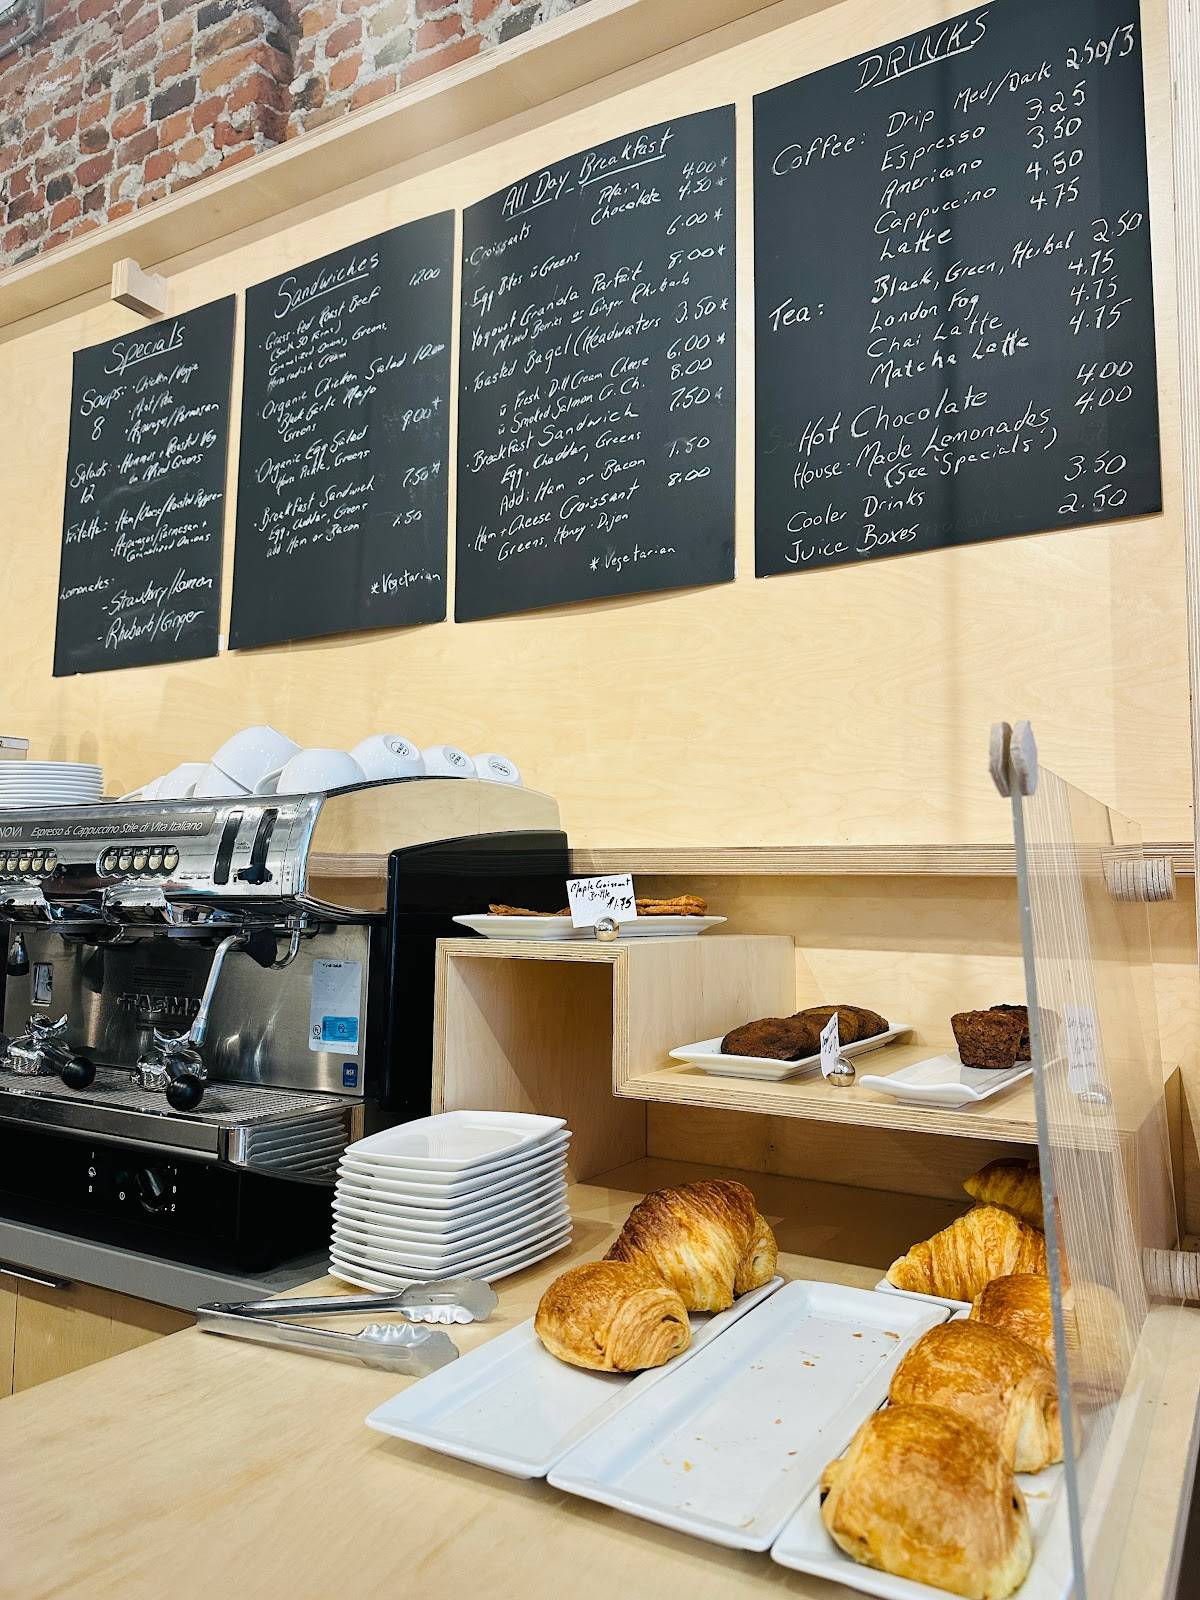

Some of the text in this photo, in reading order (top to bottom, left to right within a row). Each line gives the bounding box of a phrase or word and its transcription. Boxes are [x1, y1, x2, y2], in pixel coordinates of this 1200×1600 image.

[855, 10, 990, 92] DRINKS
[772, 23, 1135, 176] Coffee: Drip Med/Dark 2.50/3
[881, 80, 1086, 173] Espresso 3.25
[502, 127, 674, 215] All Day Breakfast
[874, 149, 1084, 234] Cappuccino 4.50
[881, 116, 1082, 206] Americano 3.50
[470, 222, 531, 266] Croissants
[599, 182, 639, 205] Plain
[591, 191, 661, 225] Chocolate
[880, 180, 1080, 261] Latte 4.75
[274, 253, 380, 318] Sandwiches
[349, 286, 381, 312] Beef
[470, 286, 494, 317] Egg
[498, 273, 523, 295] Bites
[540, 251, 580, 276] Greens
[520, 286, 579, 326] Granola
[592, 260, 643, 294] Parfait
[768, 209, 1143, 332] Tea: Black, Green, Herbal 2.50
[869, 248, 1115, 334] London Fog 4.75
[589, 297, 623, 316] Ginger
[867, 274, 1118, 359] Chai Latte 4.75
[104, 321, 186, 375] Specials
[474, 362, 519, 392] Toasted
[525, 330, 570, 374] Bagel
[869, 298, 1133, 389] Matcha Latte 4.75
[80, 386, 127, 416] Soups:
[262, 391, 307, 422] Organic
[315, 371, 357, 398] Chicken
[365, 352, 407, 380] Salad
[343, 385, 376, 408] Mayo
[510, 404, 551, 434] Smoked
[552, 394, 593, 419] Salmon
[620, 377, 645, 394] Ch.
[670, 358, 713, 380] 8.00
[514, 386, 540, 411] Fresh
[549, 375, 570, 398] Dill
[571, 370, 602, 390] Cream
[610, 356, 650, 378] Cheese
[798, 359, 1134, 456] Hot Chocolate 4.00
[92, 416, 105, 440] 8
[284, 424, 316, 442] Greens
[471, 432, 534, 473] Breakfast
[538, 403, 639, 448] Sandwich
[595, 431, 641, 449] Greens
[921, 399, 1052, 457] Lemonades
[1074, 384, 1133, 415] 4.00
[258, 454, 301, 483] Organic
[305, 439, 328, 472] Egg
[330, 425, 368, 453] Salad
[335, 450, 370, 467] Greens
[534, 478, 565, 502] Ham
[577, 473, 594, 486] or
[601, 458, 645, 480] Bacon
[668, 436, 710, 458] 1.50
[884, 465, 928, 490] (See
[80, 484, 95, 503] 12
[259, 492, 315, 531] Breakfast
[320, 475, 374, 507] Sandwich
[334, 502, 368, 519] Greens
[474, 525, 497, 552] Ham
[508, 511, 551, 536] Cheese
[559, 478, 639, 520] Croissant
[667, 466, 710, 487] 8.00
[784, 483, 1128, 564] Juice Boxes 2.50
[787, 451, 1127, 534] Cooler Drinks 3.50
[326, 523, 359, 541] Bacon
[31, 826, 64, 838] Espresso
[72, 823, 119, 837] Cappuccino
[120, 822, 137, 833] Stile
[150, 821, 167, 832] Vita
[168, 820, 203, 832] Italiano
[571, 881, 594, 898] Maple
